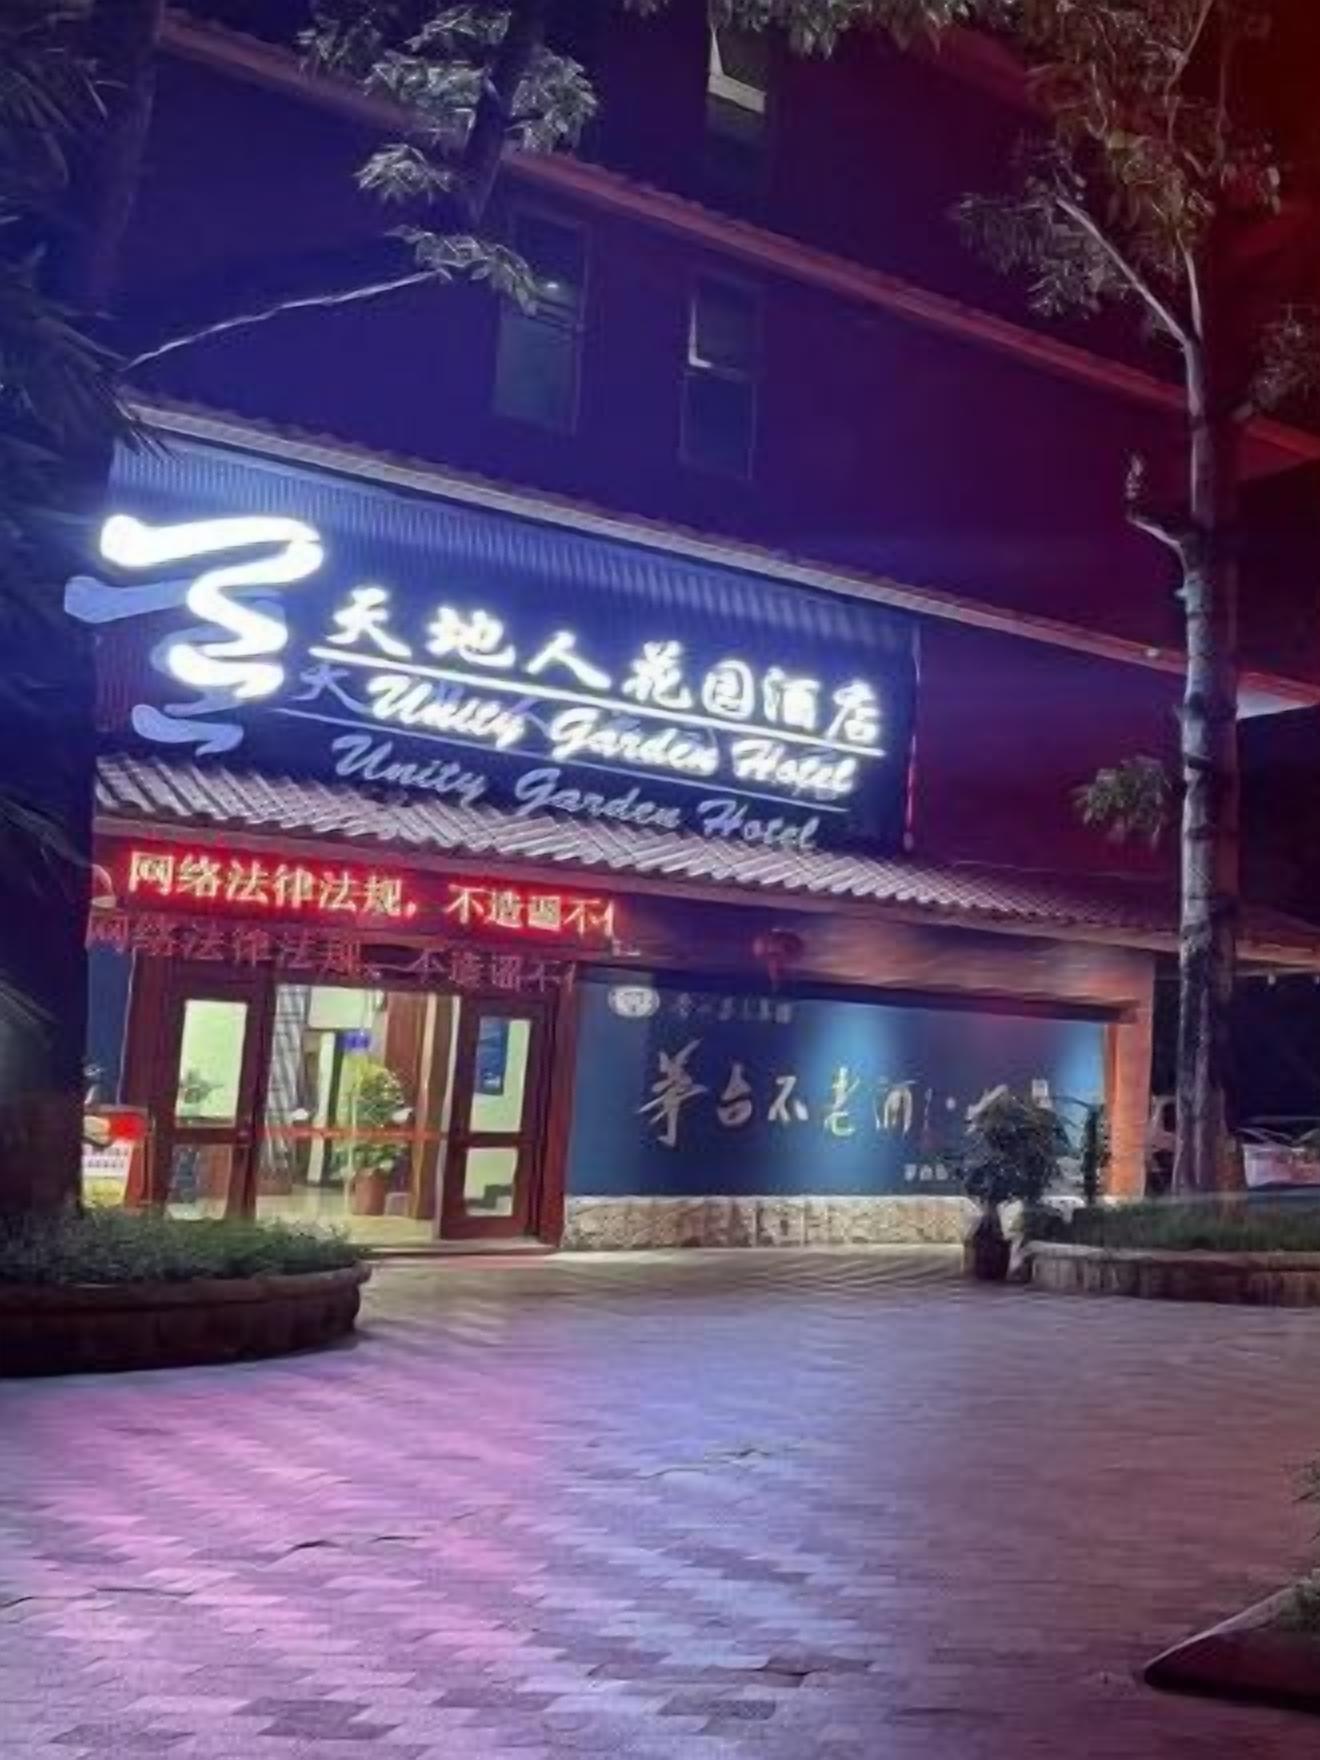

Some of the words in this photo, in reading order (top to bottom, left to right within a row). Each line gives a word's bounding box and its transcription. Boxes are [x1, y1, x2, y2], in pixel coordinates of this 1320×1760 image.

[331, 734, 488, 808] Unity
[514, 768, 682, 828] Garden
[697, 799, 821, 850] Hotel
[366, 675, 525, 750] Unity
[550, 706, 720, 777] Garden
[731, 739, 858, 793] Hotel
